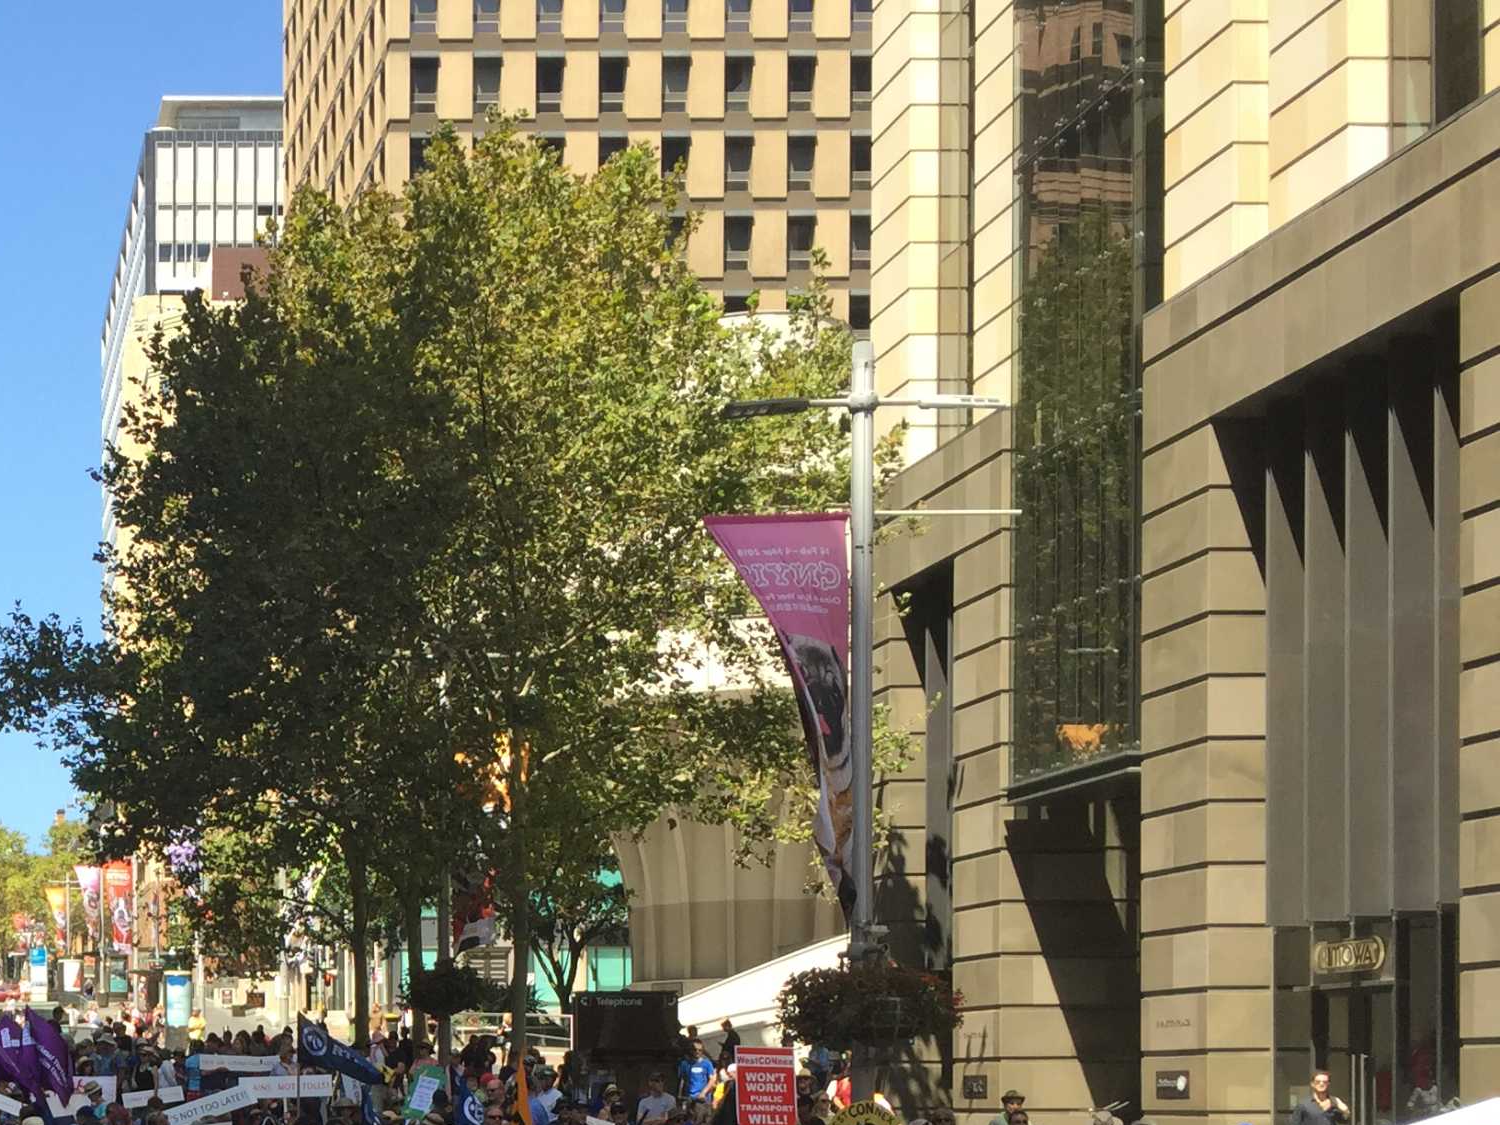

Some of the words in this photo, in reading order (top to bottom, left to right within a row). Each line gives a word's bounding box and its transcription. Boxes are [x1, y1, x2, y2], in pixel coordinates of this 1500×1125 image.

[596, 996, 643, 1008] Telephone
[744, 1072, 787, 1082] WON'T
[745, 1082, 788, 1093] WORK!
[749, 1095, 784, 1103] PUBLIC
[179, 1108, 199, 1121] NOT
[200, 1101, 220, 1115] TOO
[740, 1104, 795, 1113] TRANSPORT
[747, 1114, 789, 1125] WILL!
